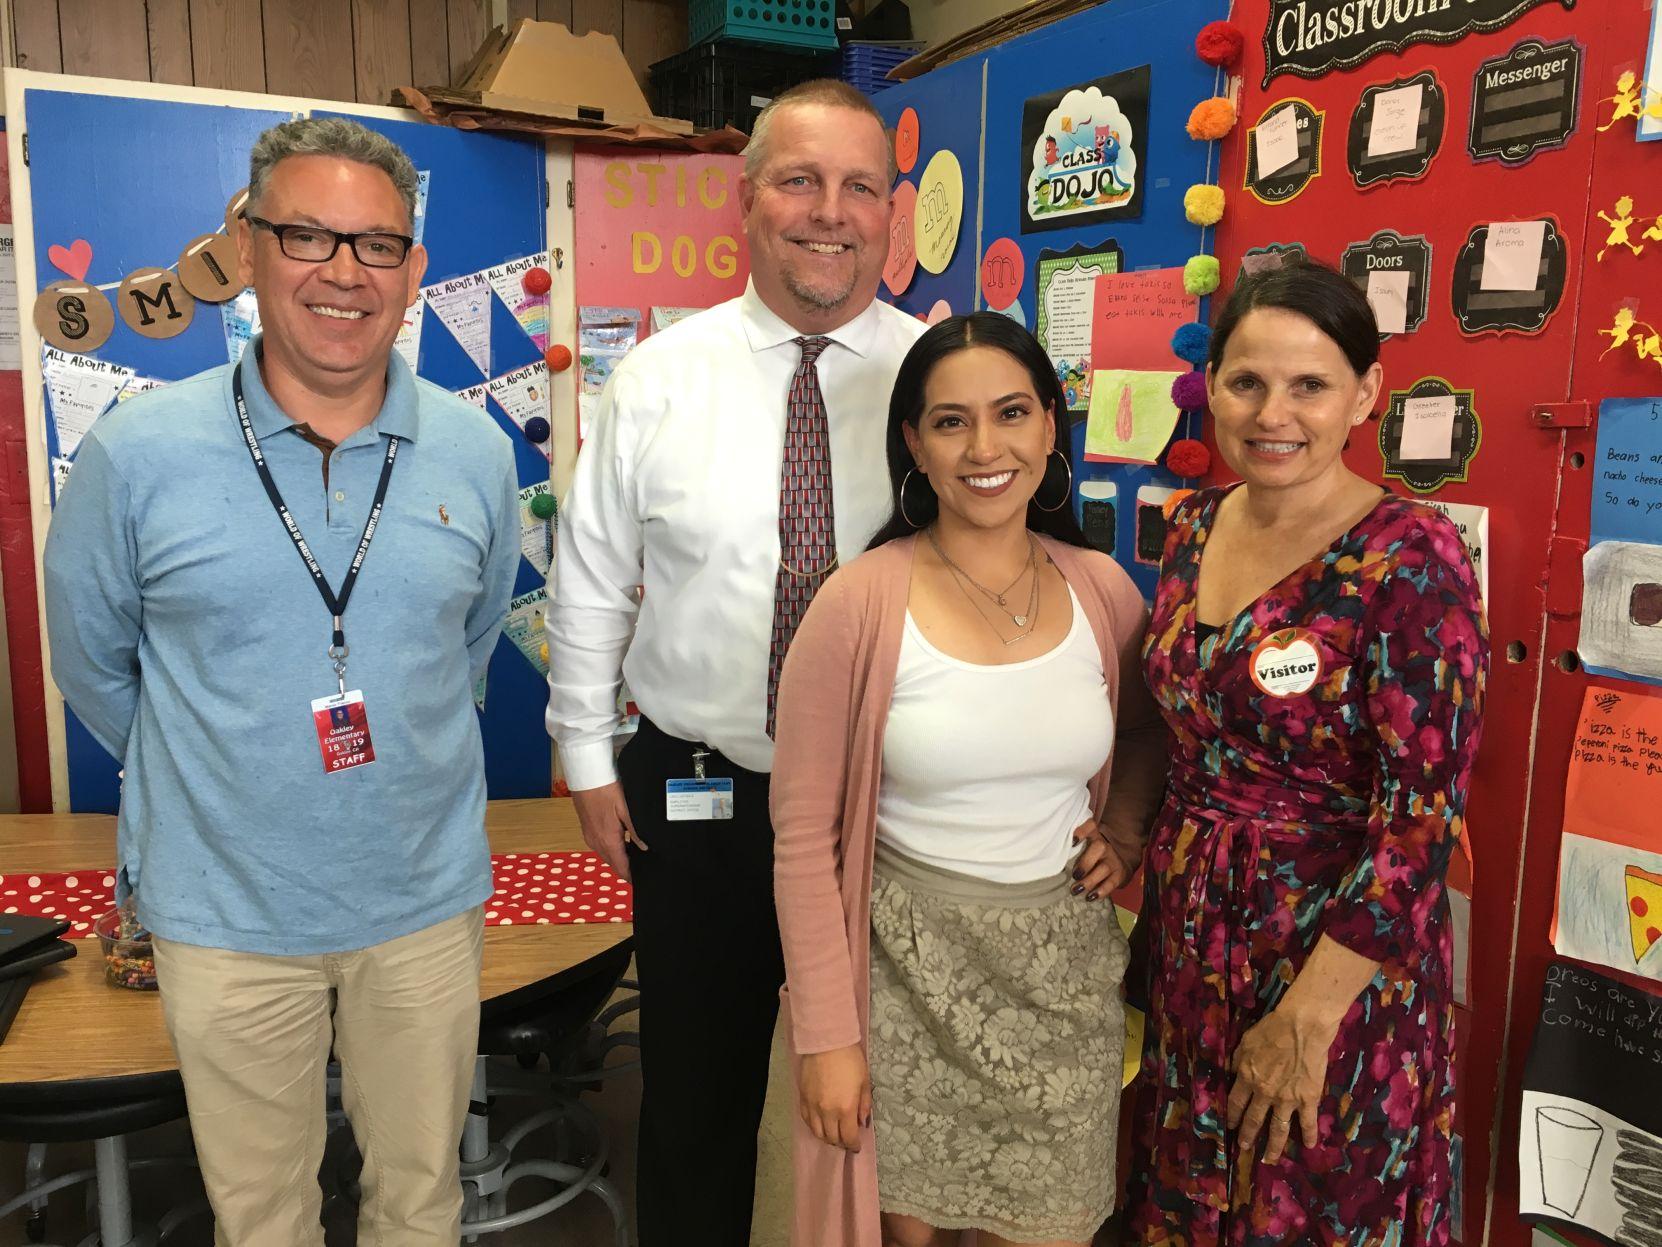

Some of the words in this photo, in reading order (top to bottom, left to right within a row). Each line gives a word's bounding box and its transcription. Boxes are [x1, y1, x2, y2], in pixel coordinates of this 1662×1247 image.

[1485, 56, 1569, 89] Messenger
[1062, 148, 1101, 168] CLASS
[1052, 169, 1114, 204] DOJO
[632, 232, 738, 279] DOG
[1366, 254, 1403, 269] Doors
[474, 273, 485, 286] M
[238, 400, 248, 420] WORLD
[242, 419, 251, 427] OF
[245, 427, 262, 460] WRESTLING
[388, 438, 398, 458] WORLD
[1608, 448, 1640, 462] Beans
[1650, 454, 1662, 464] ar
[364, 508, 381, 540] WRESTLING
[282, 511, 297, 532] WORLD
[293, 531, 302, 540] OF
[298, 540, 319, 572] WRESTLING
[361, 539, 369, 549] OF
[353, 547, 366, 568] WORLD
[1257, 662, 1316, 680] Visitor
[324, 730, 365, 744] Elementary
[329, 725, 354, 735] Oakley
[1636, 727, 1658, 745] the
[328, 744, 340, 752] 18
[352, 738, 364, 747] 19
[332, 752, 365, 768] STAFF
